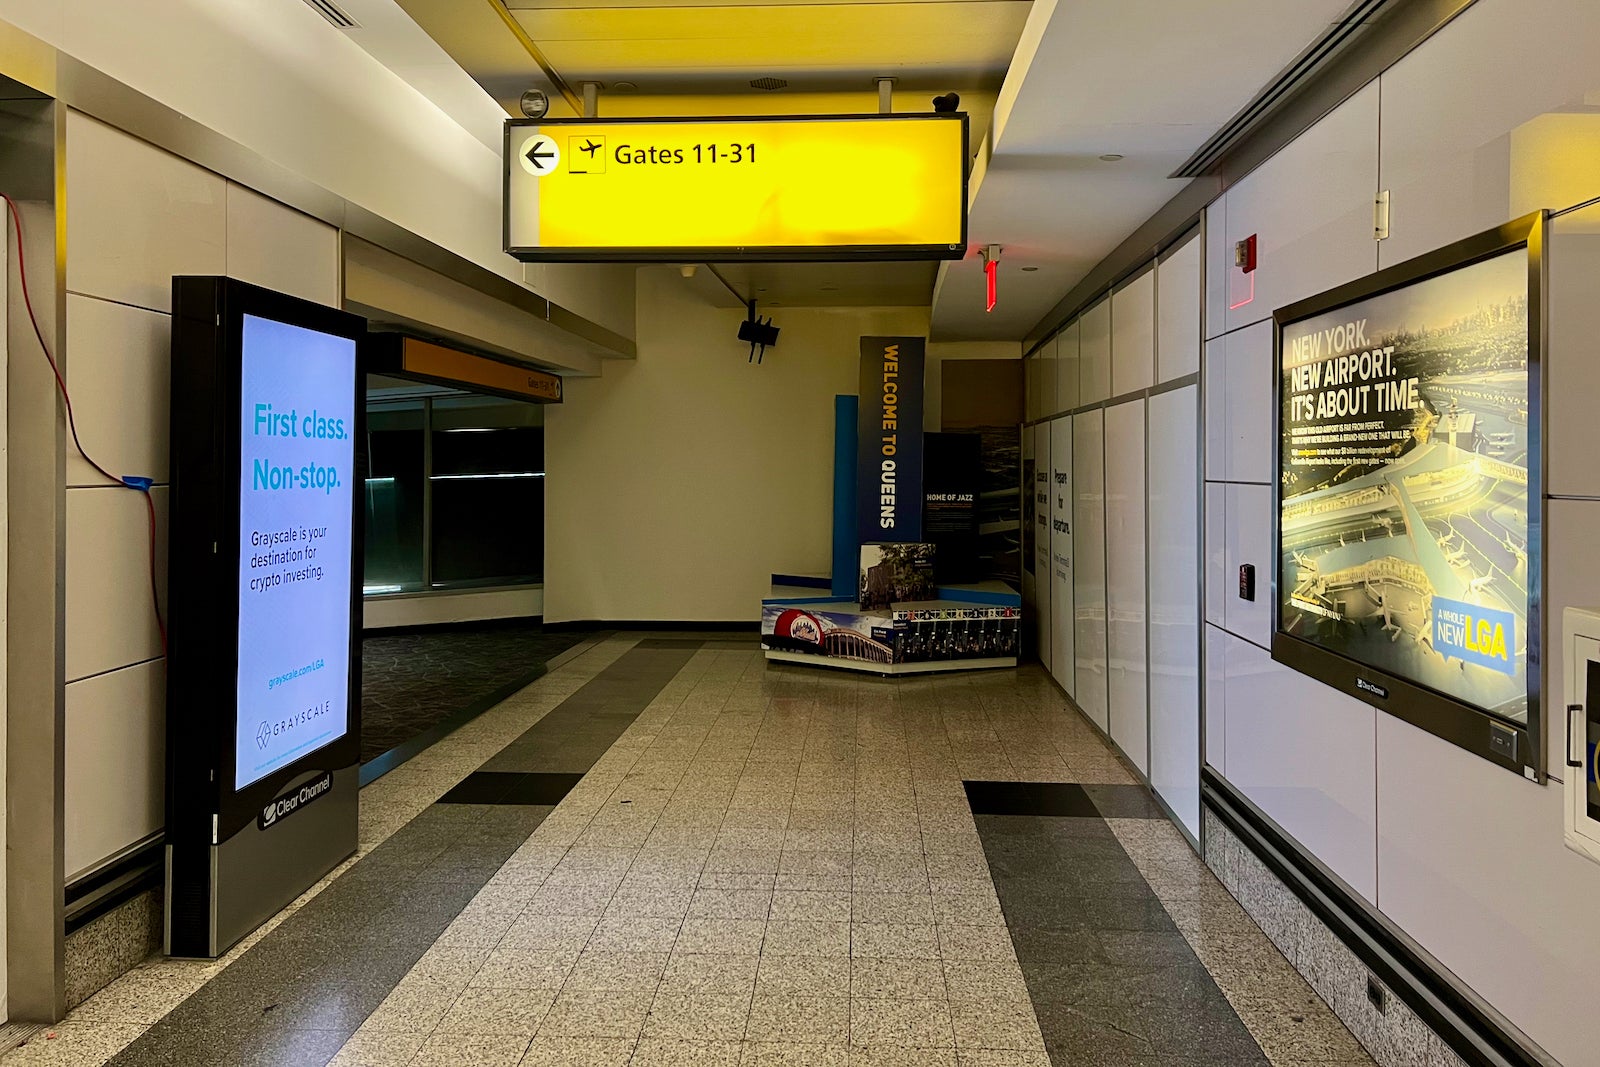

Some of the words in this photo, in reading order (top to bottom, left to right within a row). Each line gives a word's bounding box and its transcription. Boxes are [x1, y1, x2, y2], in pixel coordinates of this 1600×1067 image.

[614, 144, 684, 165] Gates
[692, 143, 757, 164] 11-31
[1292, 331, 1323, 364] NEW
[1325, 319, 1370, 355] YORK.
[1291, 362, 1323, 392] NEW
[1324, 346, 1397, 386] AIRPORT.
[882, 344, 899, 431] WELCOME
[1291, 393, 1314, 422] IT'S
[1316, 384, 1371, 419] ABOUT
[1374, 377, 1425, 413] TIME.
[254, 403, 297, 438] First
[302, 410, 348, 440] class.
[1352, 422, 1364, 431] FROM
[1368, 431, 1378, 441] ONE
[1378, 431, 1390, 440] THAT
[1391, 430, 1402, 440] WILL
[881, 434, 897, 456] TO
[253, 458, 341, 495] Non-stop.
[880, 460, 897, 529] QUEENS
[926, 493, 947, 502] HOME
[947, 493, 957, 502] OF
[957, 493, 974, 502] JAZZ
[251, 526, 297, 547] Grayscale
[300, 526, 307, 541] is
[308, 526, 327, 545] your
[250, 548, 303, 569] destination
[304, 545, 317, 561] for
[250, 571, 281, 593] crypto
[283, 566, 324, 584] investing.
[1437, 609, 1443, 619] A
[1443, 610, 1465, 626] WHOLE
[1437, 620, 1465, 649] NEW
[1465, 615, 1508, 661] LGA
[273, 700, 331, 736] GRAYSCALE
[277, 795, 299, 817] Clear
[300, 774, 330, 803] Channel
